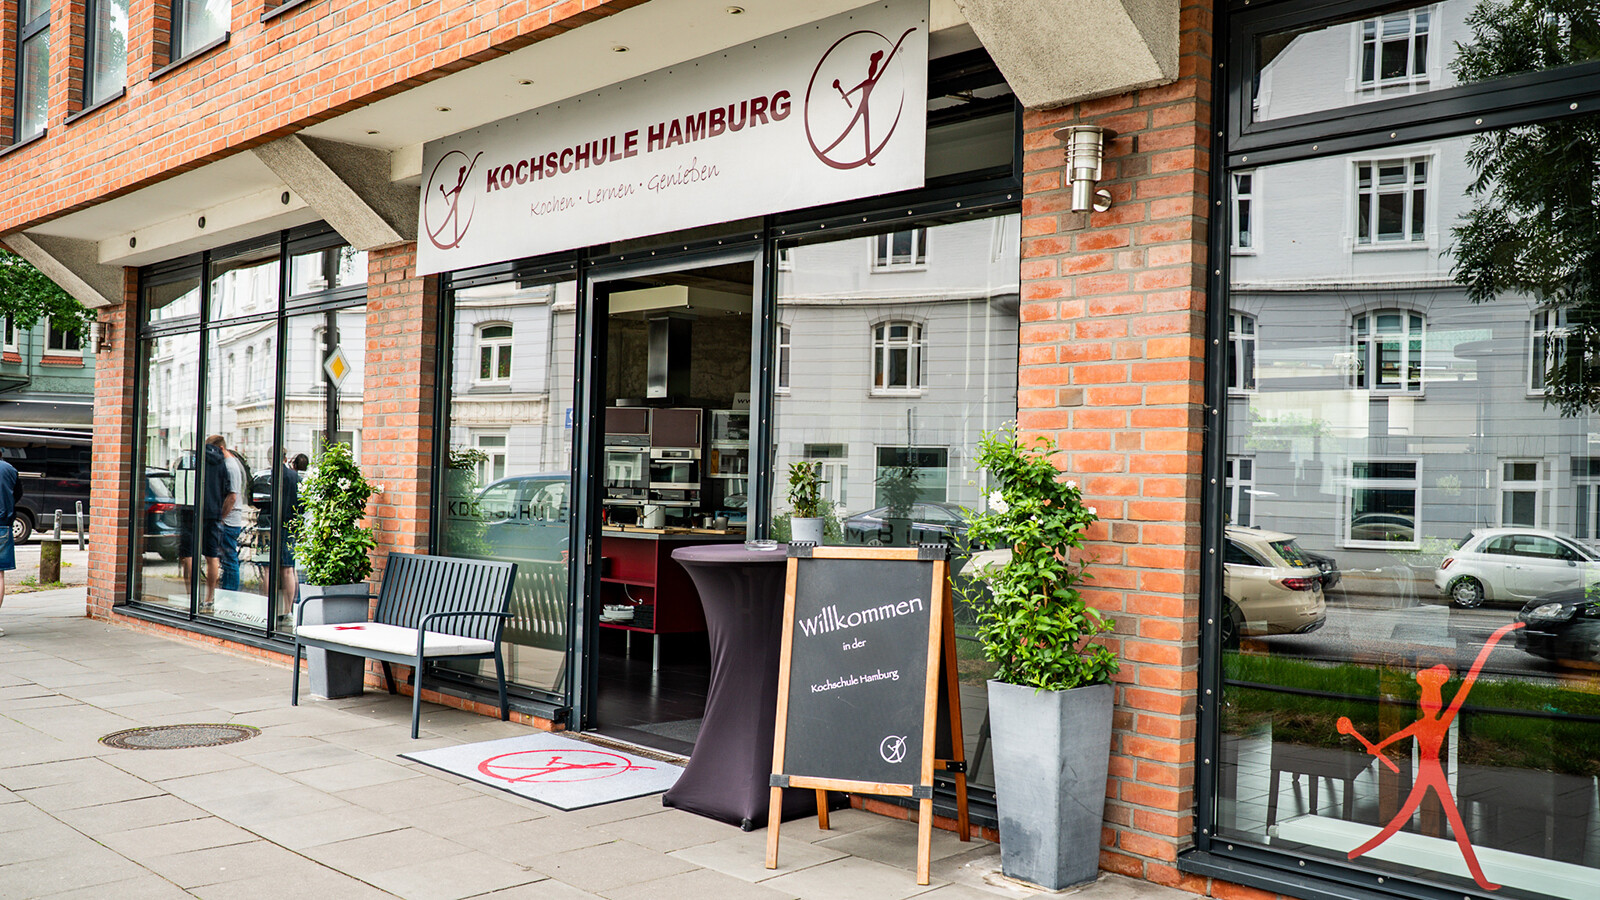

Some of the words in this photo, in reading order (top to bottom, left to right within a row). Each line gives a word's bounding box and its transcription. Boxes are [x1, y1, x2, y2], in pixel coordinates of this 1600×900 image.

[486, 129, 639, 193] KOCHSCHULE
[647, 89, 792, 153] HAMBURG
[530, 196, 576, 216] Kochen
[586, 183, 635, 205] Lernen
[647, 156, 720, 193] Genießen
[799, 597, 923, 637] Willkommen
[842, 641, 851, 651] in
[851, 637, 867, 649] der
[811, 674, 859, 693] Kochschule
[859, 668, 900, 684] Hamburg
